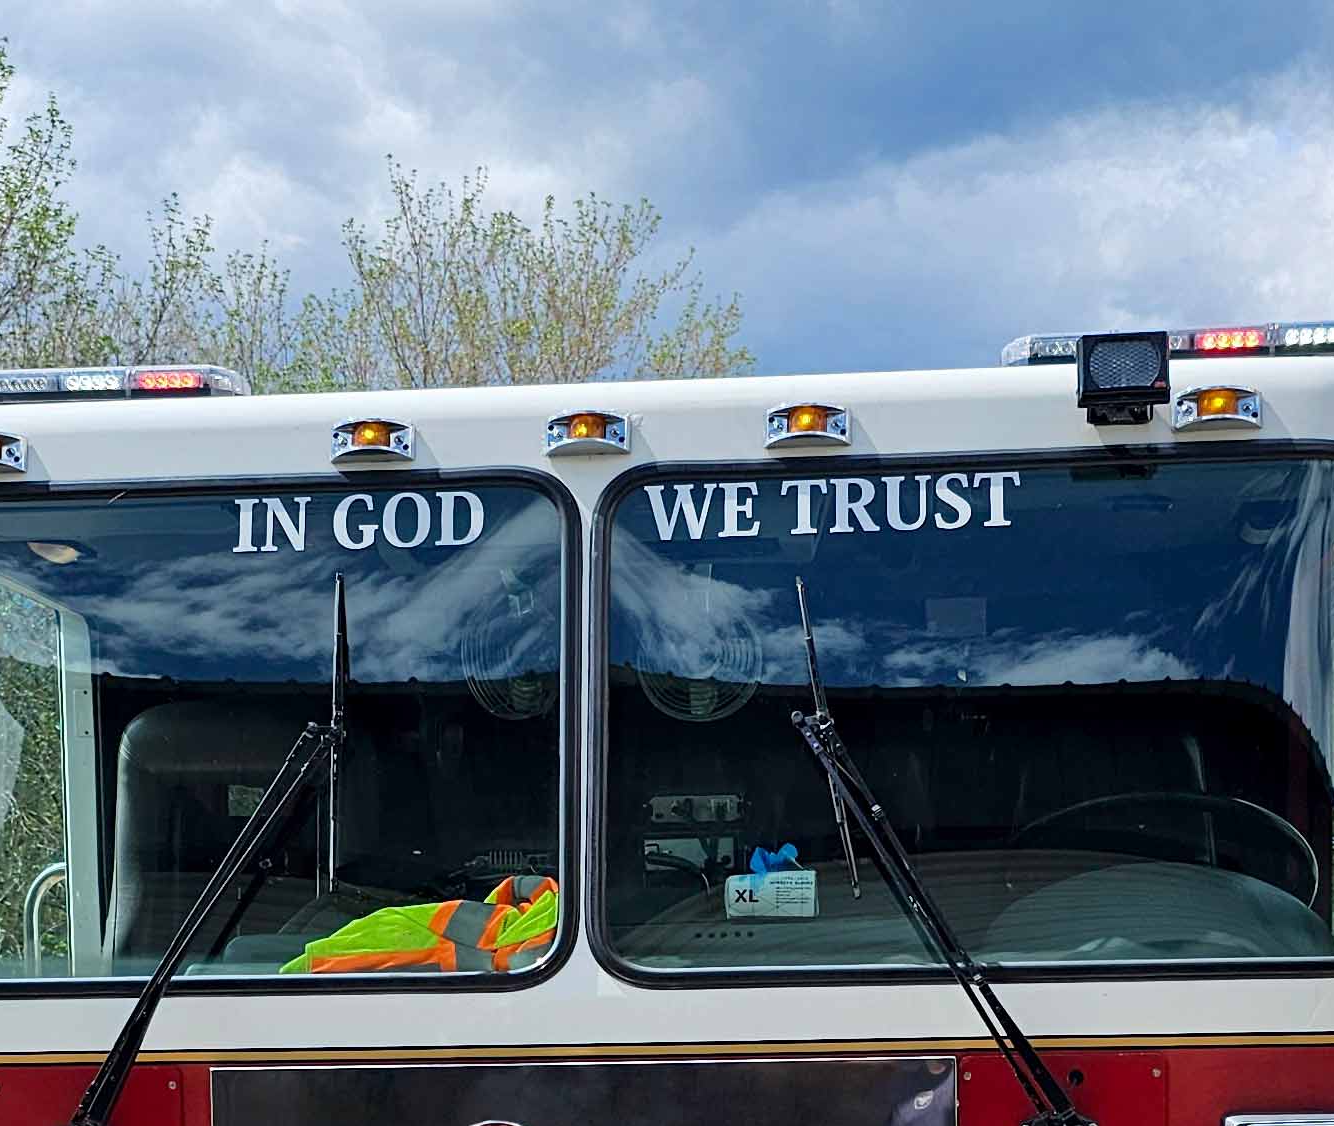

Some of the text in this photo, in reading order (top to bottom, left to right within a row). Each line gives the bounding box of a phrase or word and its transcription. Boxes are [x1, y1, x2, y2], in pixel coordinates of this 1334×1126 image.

[232, 471, 1021, 554] IN GOD WE TRUST
[734, 889, 760, 903] XL
